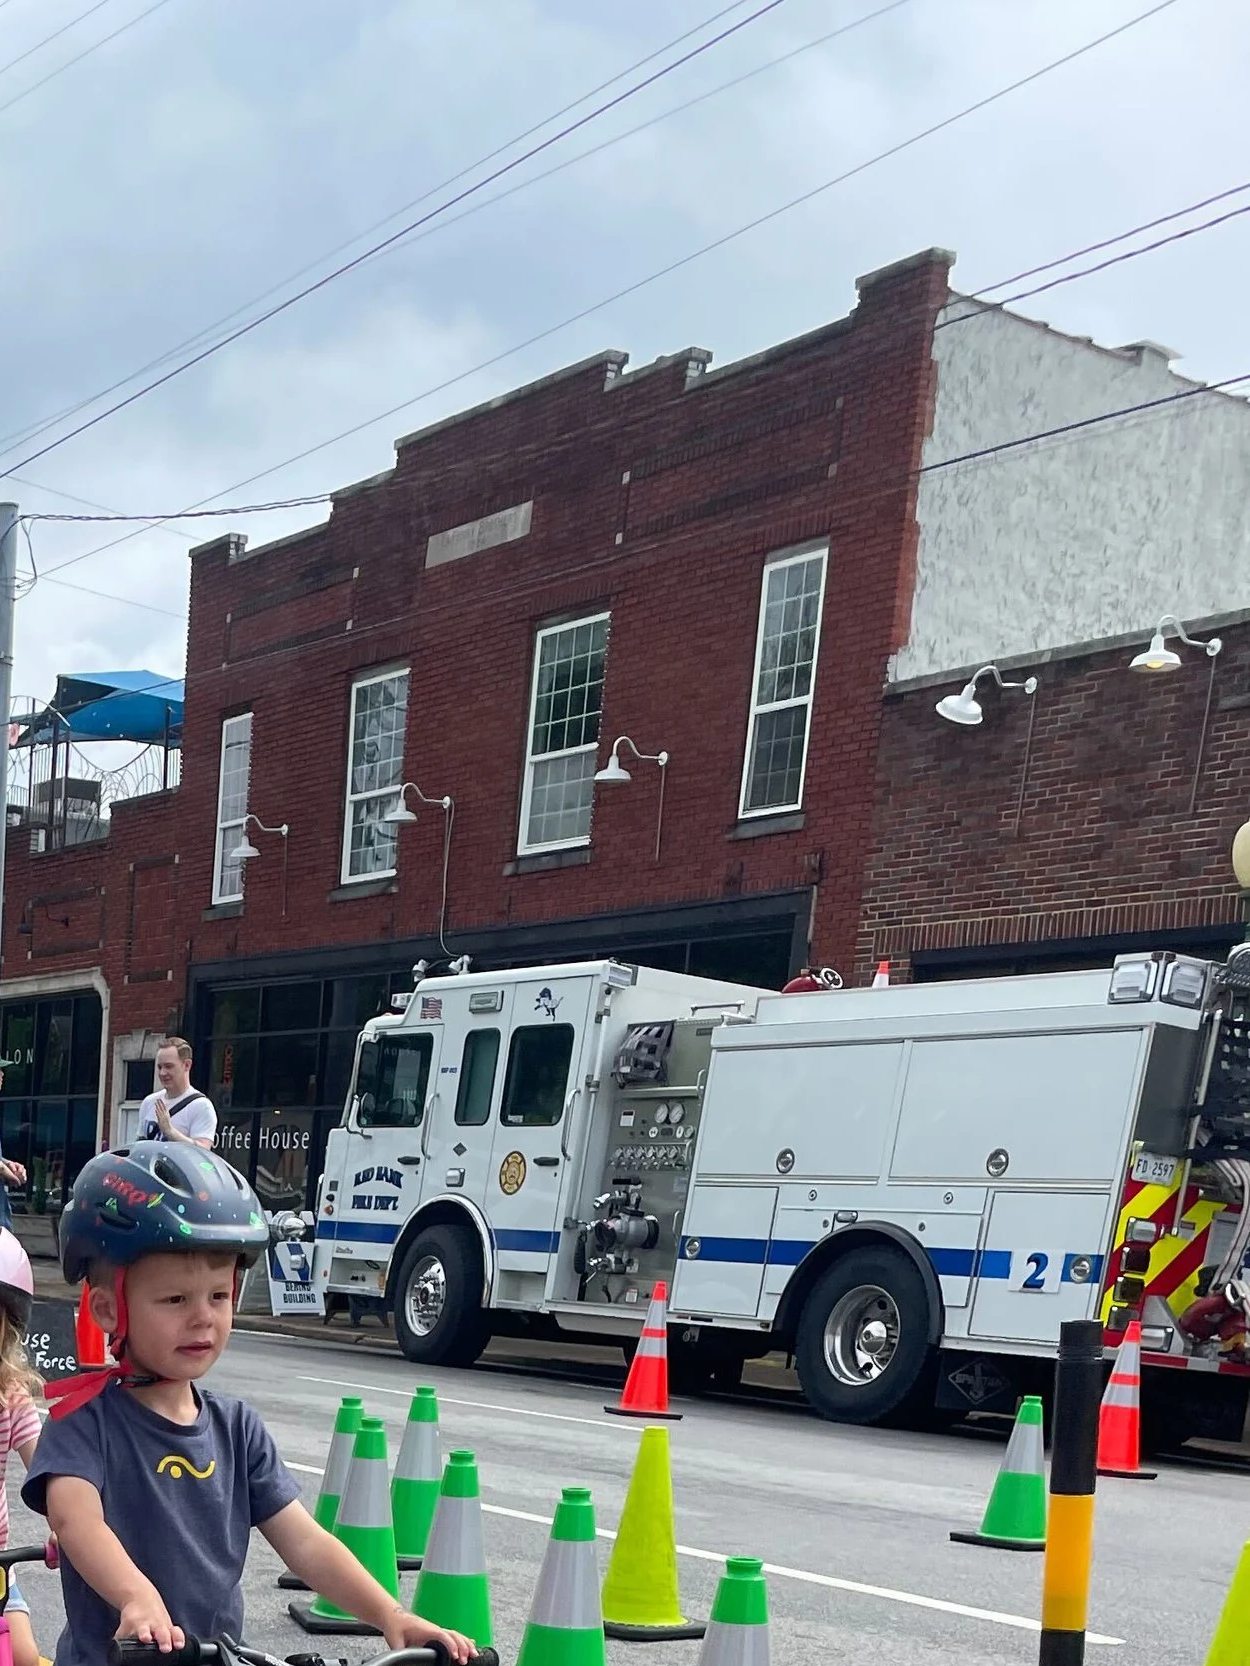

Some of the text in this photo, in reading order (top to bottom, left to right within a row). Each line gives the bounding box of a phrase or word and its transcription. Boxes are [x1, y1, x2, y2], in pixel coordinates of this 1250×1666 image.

[212, 1125, 310, 1150] offee House
[1135, 1158, 1175, 1178] FD 2597
[1022, 1252, 1049, 1289] 2
[282, 1292, 317, 1304] BUILDING
[35, 1351, 78, 1371] Force
